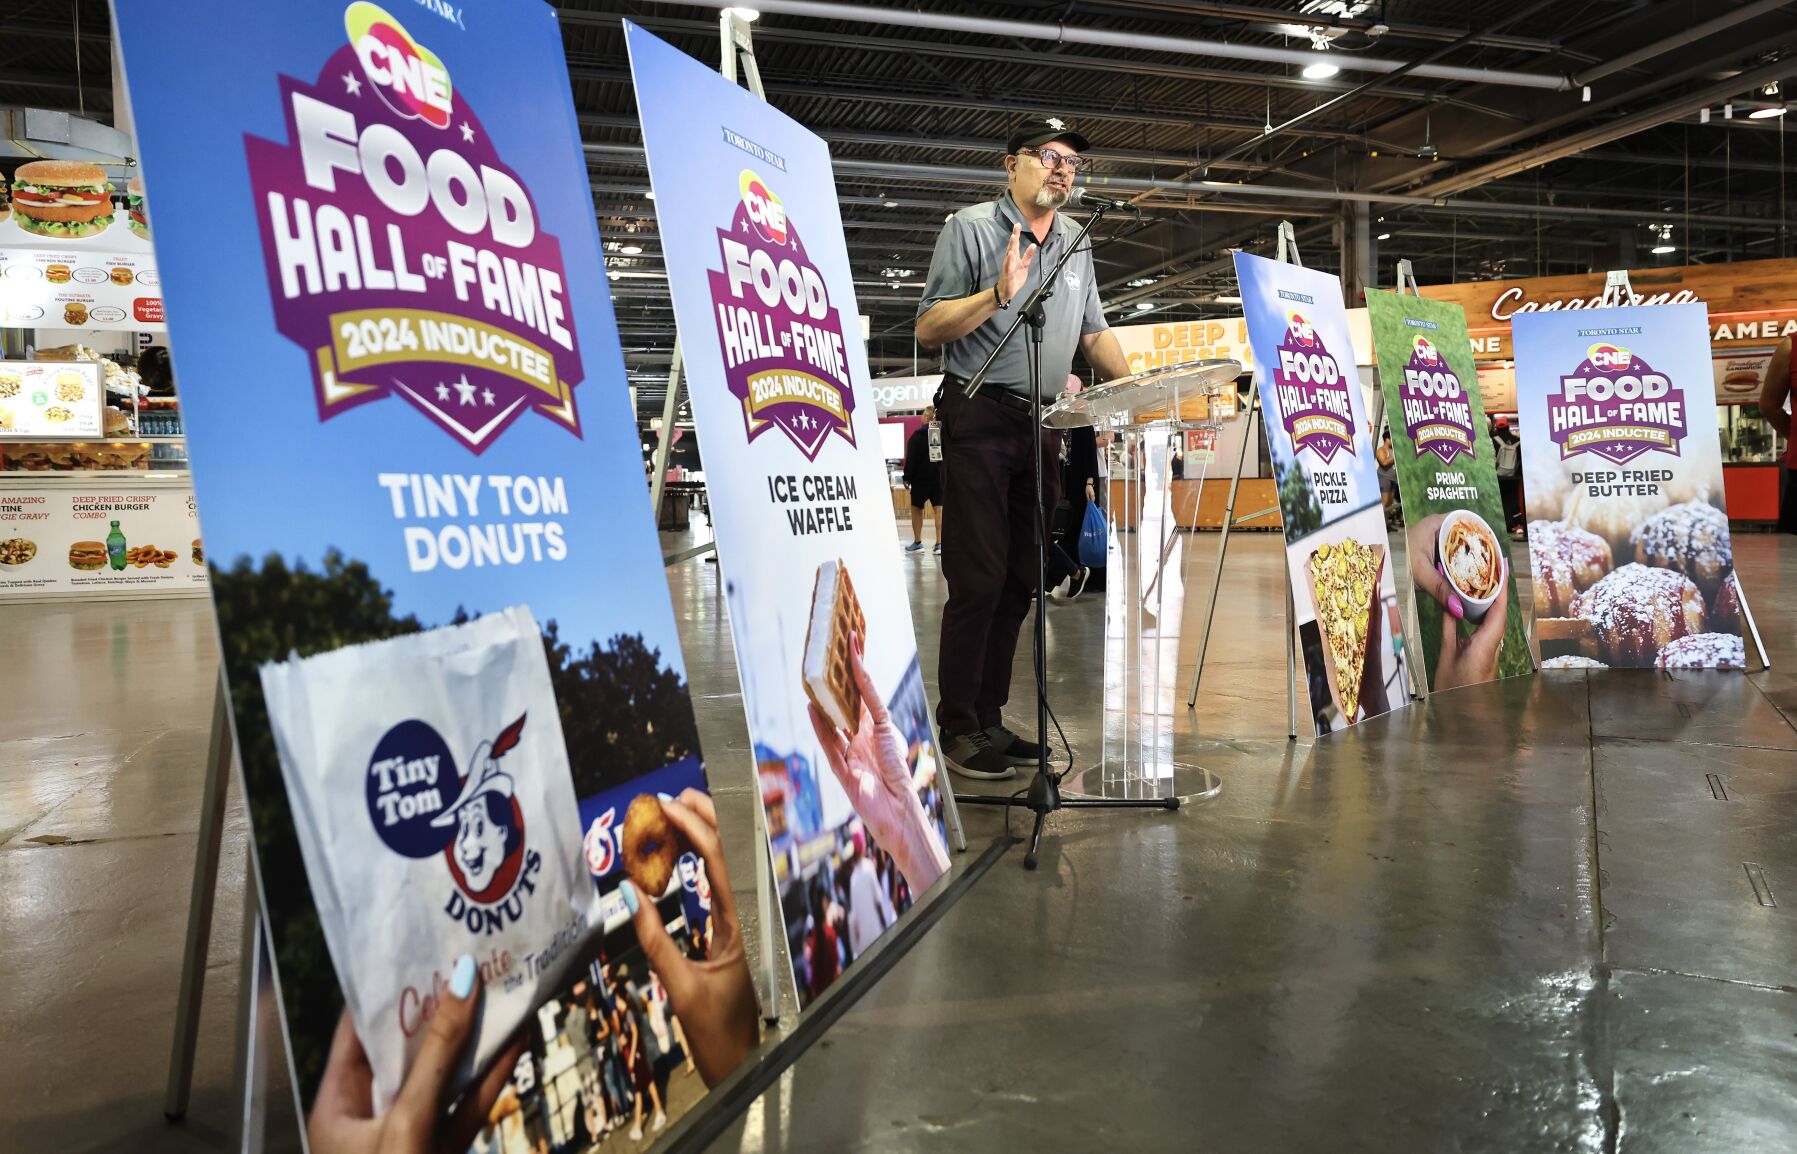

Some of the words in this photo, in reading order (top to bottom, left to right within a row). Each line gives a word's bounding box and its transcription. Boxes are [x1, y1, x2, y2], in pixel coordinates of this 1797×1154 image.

[358, 34, 453, 114] CNE
[724, 129, 765, 159] TORONTO
[764, 150, 785, 170] STAR
[291, 91, 536, 249] FOOD
[744, 191, 788, 234] CNE
[267, 191, 428, 299] HALL
[422, 253, 449, 280] OF
[447, 240, 574, 352] FAME
[722, 237, 828, 321] FOOD
[1153, 322, 1225, 350] DEEP
[1291, 321, 1314, 340] CNE
[1581, 328, 1618, 336] TORONTO
[1709, 319, 1797, 341] AMEA
[340, 317, 419, 360] 2024
[419, 318, 552, 385] INDUCTEE
[718, 303, 785, 369] HALL
[780, 331, 792, 348] OF
[790, 320, 850, 388] FAME
[1415, 343, 1437, 360] CNE
[1591, 351, 1632, 366] CNE
[1280, 349, 1339, 385] FOOD
[751, 376, 783, 403] 2024
[782, 375, 841, 411] INDUCTEE
[872, 385, 918, 407] ogen
[1405, 369, 1461, 399] FOOD
[1564, 375, 1670, 402] FOOD
[1278, 385, 1313, 418] HALL
[1316, 386, 1353, 422] FAME
[1404, 398, 1435, 427] HALL
[1437, 399, 1472, 430] FAME
[1553, 403, 1608, 432] HALL
[1607, 409, 1619, 417] OF
[1619, 401, 1683, 428] FAME
[1295, 419, 1312, 435] 2024
[1311, 418, 1347, 437] INDUCTEE
[1417, 428, 1434, 441] 2024
[1433, 427, 1466, 442] INDUCTEE
[1571, 430, 1601, 443] 2024
[1602, 429, 1666, 440] INDUCTEE
[768, 475, 800, 503] ICE
[802, 475, 858, 502] CREAM
[1314, 472, 1348, 487] PICKLE
[1435, 472, 1465, 485] PRIMO
[1571, 471, 1617, 484] DEEP
[1622, 470, 1674, 483] FRIED
[1588, 483, 1659, 497] BUTTER
[114, 503, 150, 511] BURGER
[377, 472, 483, 519] TINY
[487, 474, 570, 516] TOM
[1320, 489, 1348, 504] PIZZA
[1427, 486, 1478, 501] SPAGHETTI
[19, 512, 50, 520] GRAVY
[786, 506, 853, 536] WAFFLE
[403, 521, 568, 573] DONUTS
[370, 753, 441, 793] Tiny
[377, 786, 443, 827] Tom
[444, 849, 542, 935] DONUTS
[399, 949, 513, 1038] Celate
